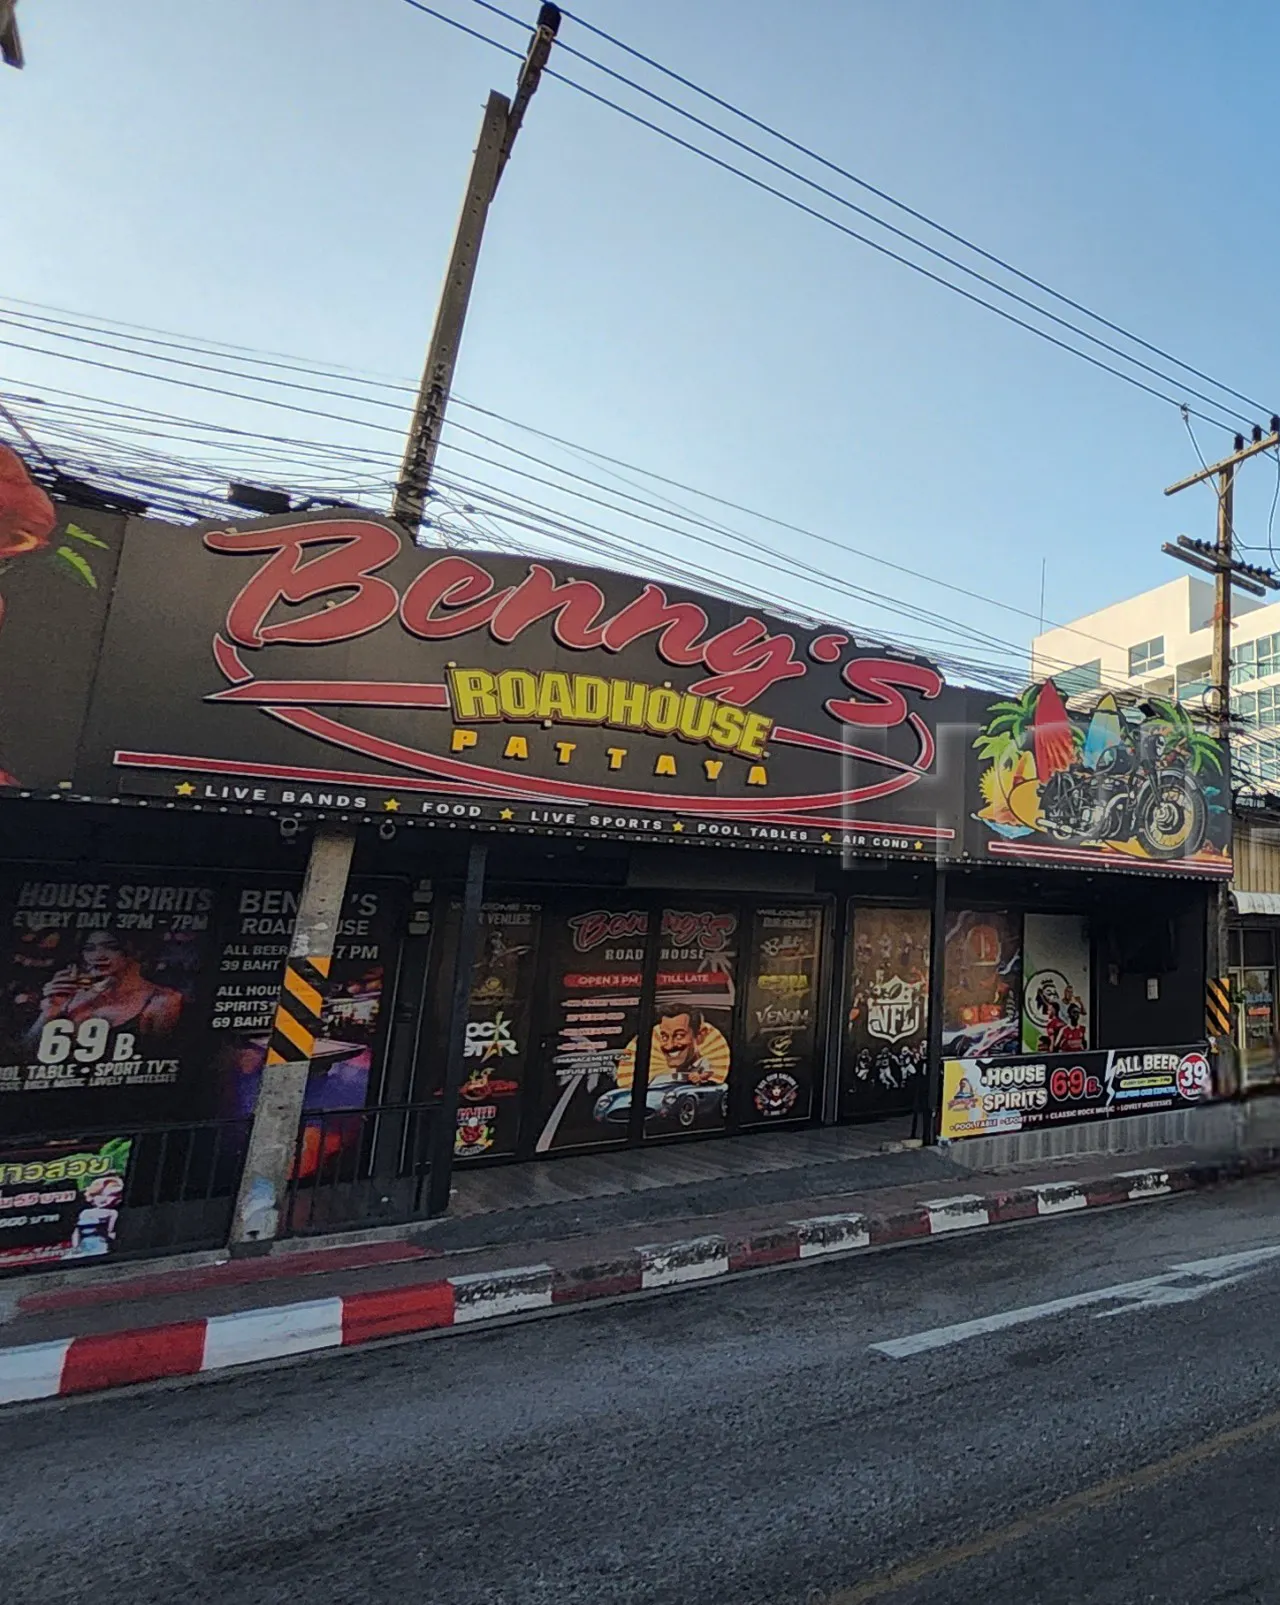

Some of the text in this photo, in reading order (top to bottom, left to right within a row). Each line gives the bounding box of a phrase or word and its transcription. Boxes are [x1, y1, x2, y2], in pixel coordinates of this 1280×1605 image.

[203, 519, 946, 727] Benny's
[450, 668, 773, 758] ROADHOUSE
[451, 729, 768, 786] PATTAYA
[204, 785, 909, 850] LIVE BANDS FOOD LIVE SPORTS POOL TABLES AIR COND
[17, 881, 214, 912] HOUSE SPIRITS
[238, 888, 379, 917] BEN'S
[76, 911, 112, 929] DAY
[116, 912, 155, 930] 3PM
[170, 914, 209, 932] 7PM
[486, 912, 531, 925] VENUES
[223, 944, 249, 956] ALL
[349, 945, 379, 960] PM
[605, 947, 704, 961] ROAD HOUSE
[220, 960, 281, 971] 39 BAHT
[579, 974, 611, 985] OPEN
[620, 972, 640, 984] PM
[662, 972, 684, 982] TILL
[685, 970, 709, 982] LATE
[216, 985, 244, 997] ALL
[211, 1015, 271, 1028] 69 BAHT
[756, 1002, 810, 1024] VENOM
[869, 1005, 915, 1035] NFL
[37, 1018, 110, 1064] 69
[27, 1063, 77, 1080] TABLE
[94, 1060, 143, 1077] SPORT
[146, 1058, 180, 1074] TV'S
[556, 1055, 613, 1064] MANAGEMENT
[1115, 1053, 1180, 1075] ALL BEER
[985, 1064, 1047, 1086] HOUSE
[1051, 1066, 1087, 1101] 69
[1181, 1060, 1206, 1087] 39
[982, 1088, 1048, 1111] SPIRITS
[955, 1122, 973, 1130] POOL
[976, 1118, 997, 1127] TABLE
[1005, 1114, 1027, 1124] SPORT
[1050, 1109, 1076, 1119] CLASSIC
[1077, 1107, 1094, 1116] ROCK
[1095, 1105, 1115, 1114] MUSIC
[1119, 1102, 1141, 1112] LOVELY
[0, 1157, 112, 1184] าวสวย
